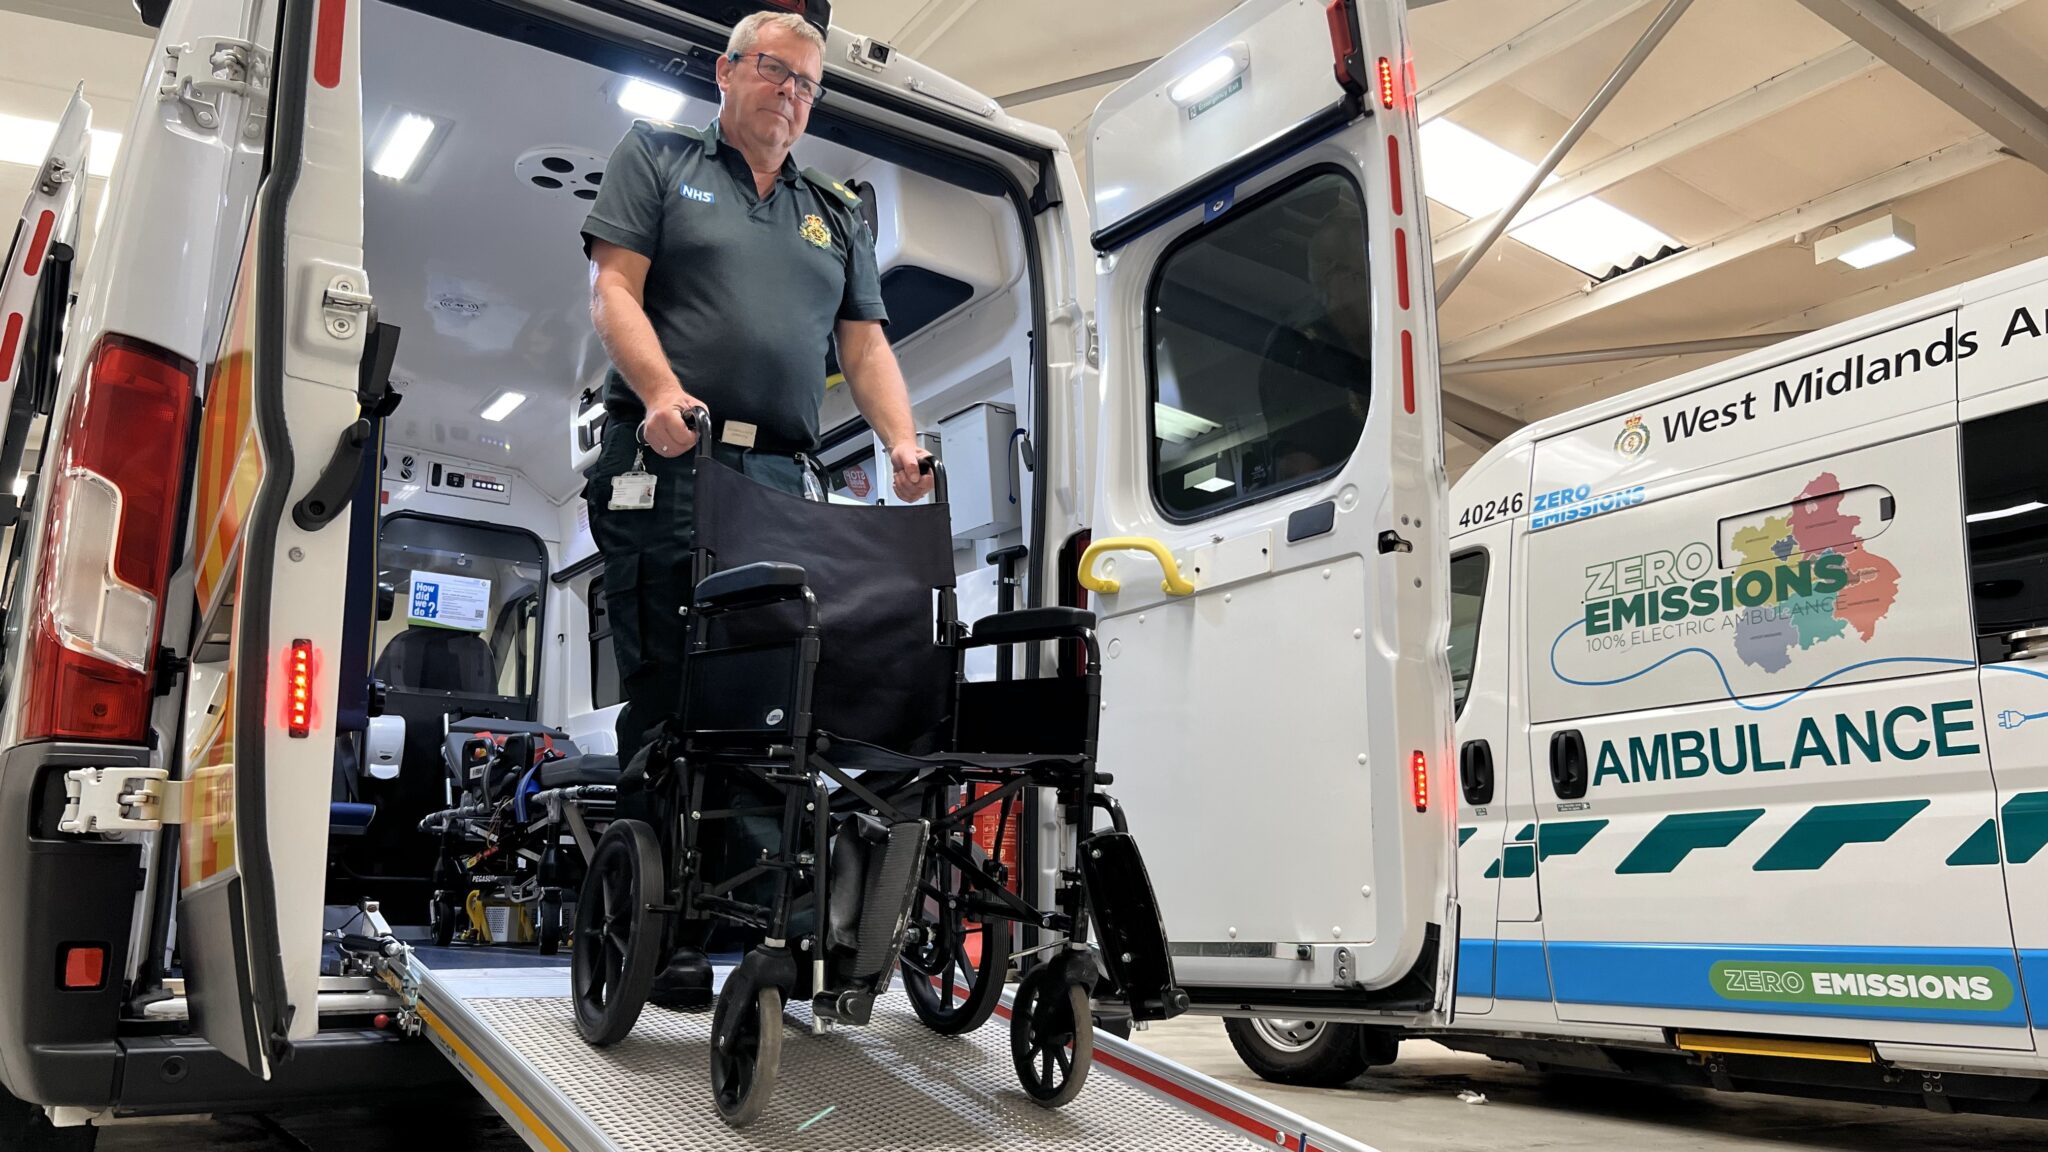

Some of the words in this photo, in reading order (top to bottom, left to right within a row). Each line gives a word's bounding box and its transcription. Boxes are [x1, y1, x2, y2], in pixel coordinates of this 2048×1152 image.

[683, 184, 713, 202] NHS
[1662, 391, 1756, 444] West
[1773, 326, 1978, 413] Midlands
[2001, 306, 2048, 347] A
[1459, 491, 1523, 528] 40246
[1531, 485, 1645, 529] EMISSIONS
[1533, 483, 1591, 513] ZERO
[416, 582, 435, 592] How
[1585, 541, 1713, 601] ZERO
[415, 592, 429, 601] did
[1585, 554, 1848, 636] EMISSIONS
[1586, 633, 1626, 653] 100%
[1631, 617, 1715, 645] ELECTRIC
[1721, 594, 1849, 631] AMBULANCE
[1592, 699, 1981, 787] AMBULANCE
[1723, 969, 1804, 994] ZERO
[1811, 971, 1993, 1001] EMISSIONS
